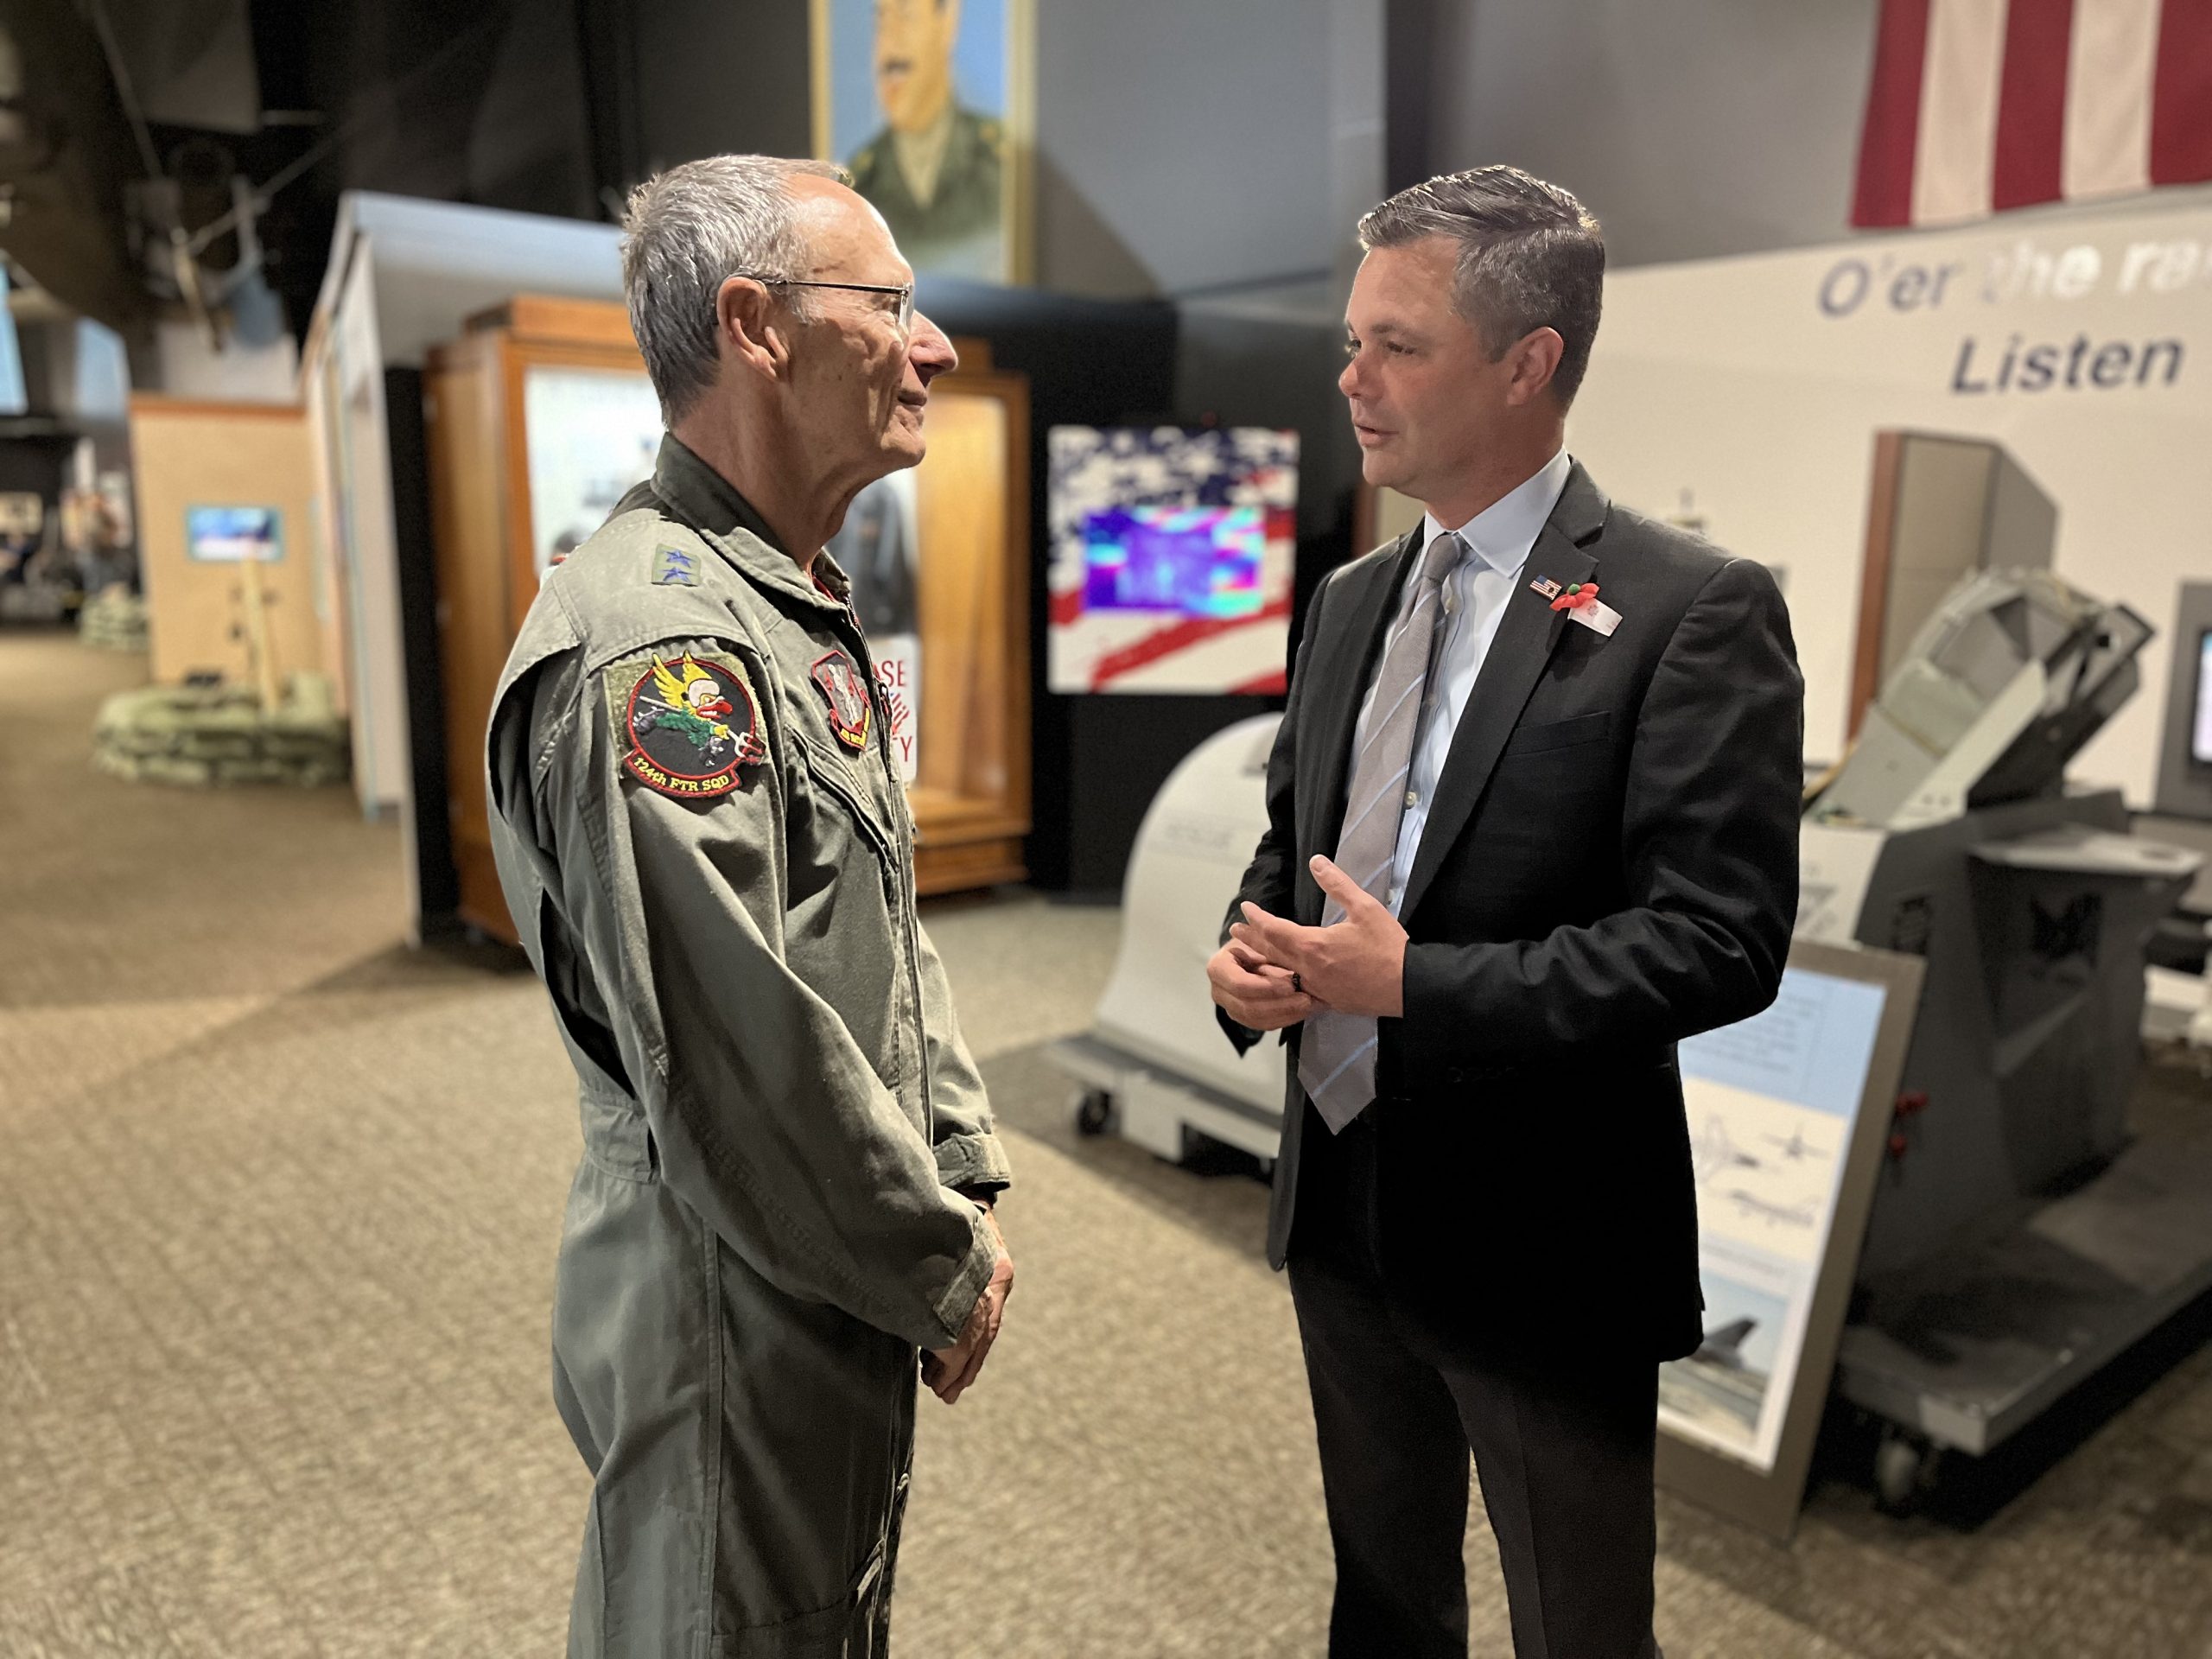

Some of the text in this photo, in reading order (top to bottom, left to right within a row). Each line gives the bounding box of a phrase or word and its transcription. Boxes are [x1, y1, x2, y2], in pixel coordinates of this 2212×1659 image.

[1818, 254, 1965, 320] O'er
[2120, 240, 2212, 292] ra
[1951, 332, 2184, 394] Listen
[634, 757, 729, 791] 124th FTR SQD
